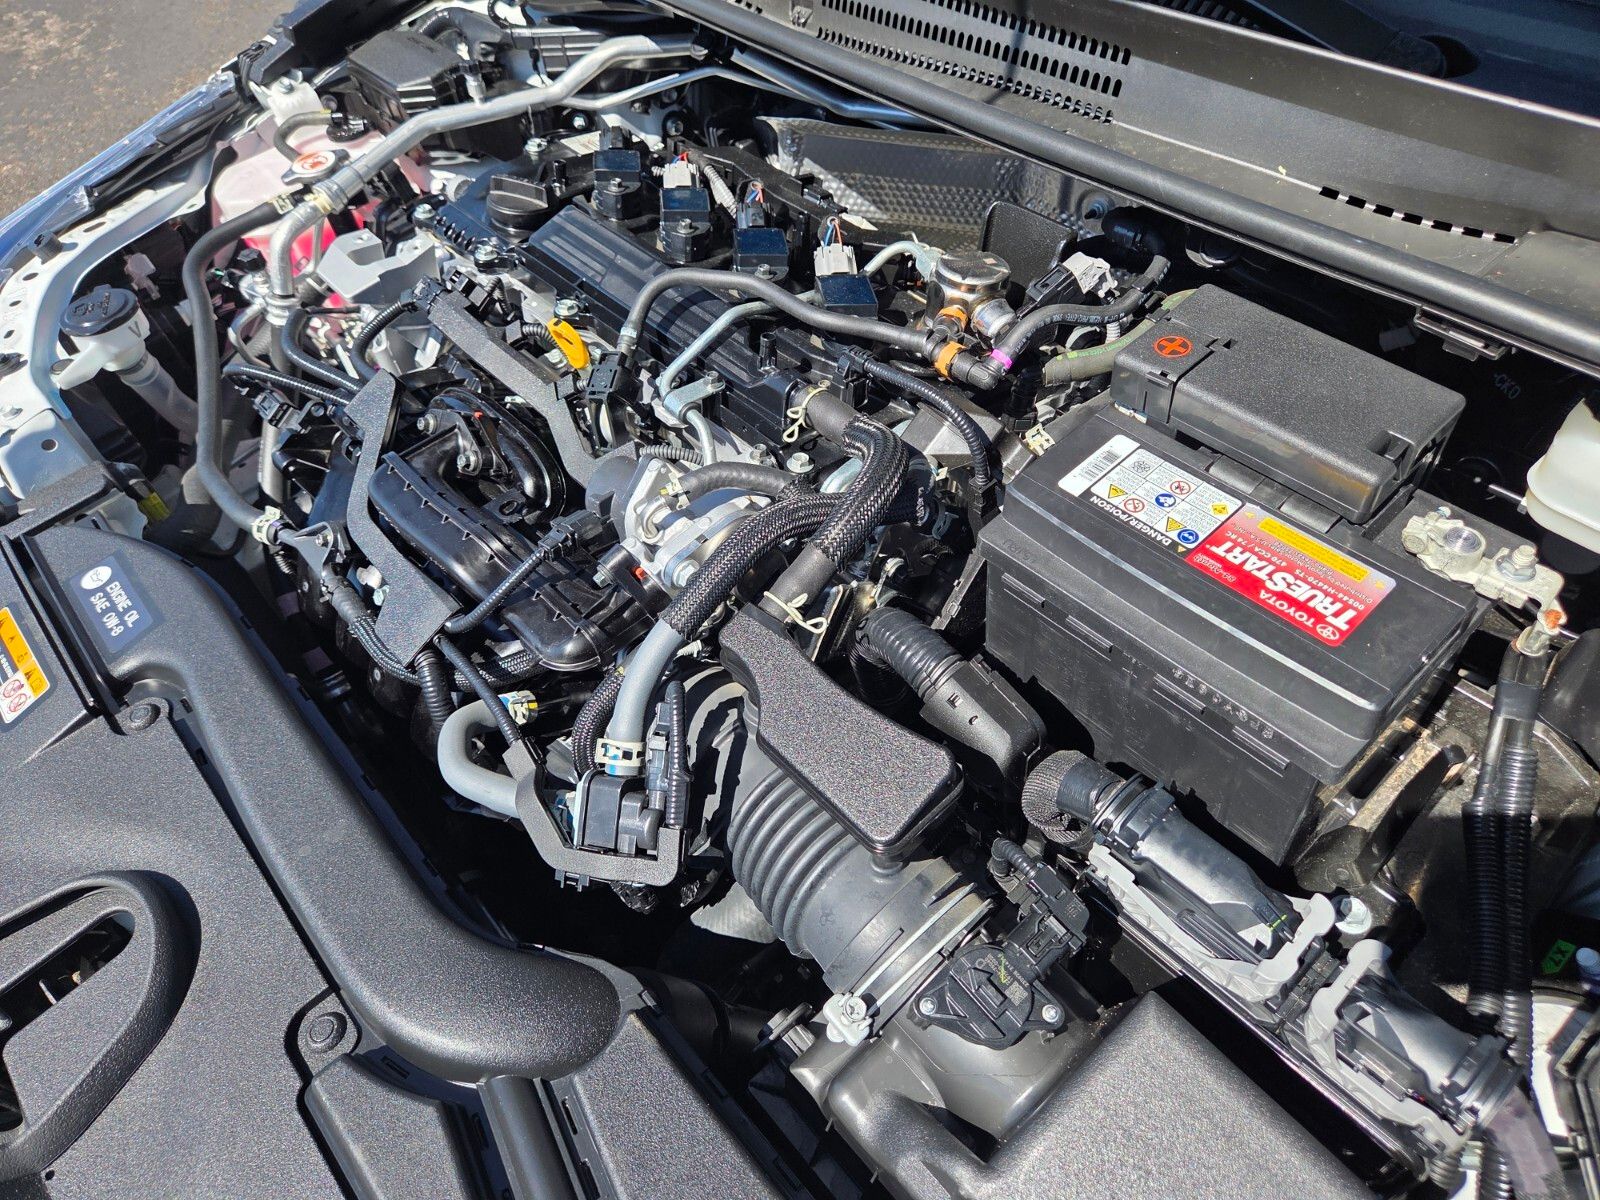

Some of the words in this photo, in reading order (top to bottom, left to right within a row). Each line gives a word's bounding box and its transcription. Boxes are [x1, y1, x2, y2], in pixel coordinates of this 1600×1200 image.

[1090, 495, 1172, 546] DANGER/POISON
[1225, 530, 1236, 539] RC
[1236, 537, 1248, 545] 74
[1254, 546, 1272, 559] CCA
[1271, 556, 1288, 568] 470
[1294, 568, 1365, 611] 00544-H4470-TS
[90, 592, 111, 613] SAE
[106, 582, 132, 612] ENGINE
[124, 610, 140, 628] OIL
[1259, 589, 1315, 627] TOYOTA
